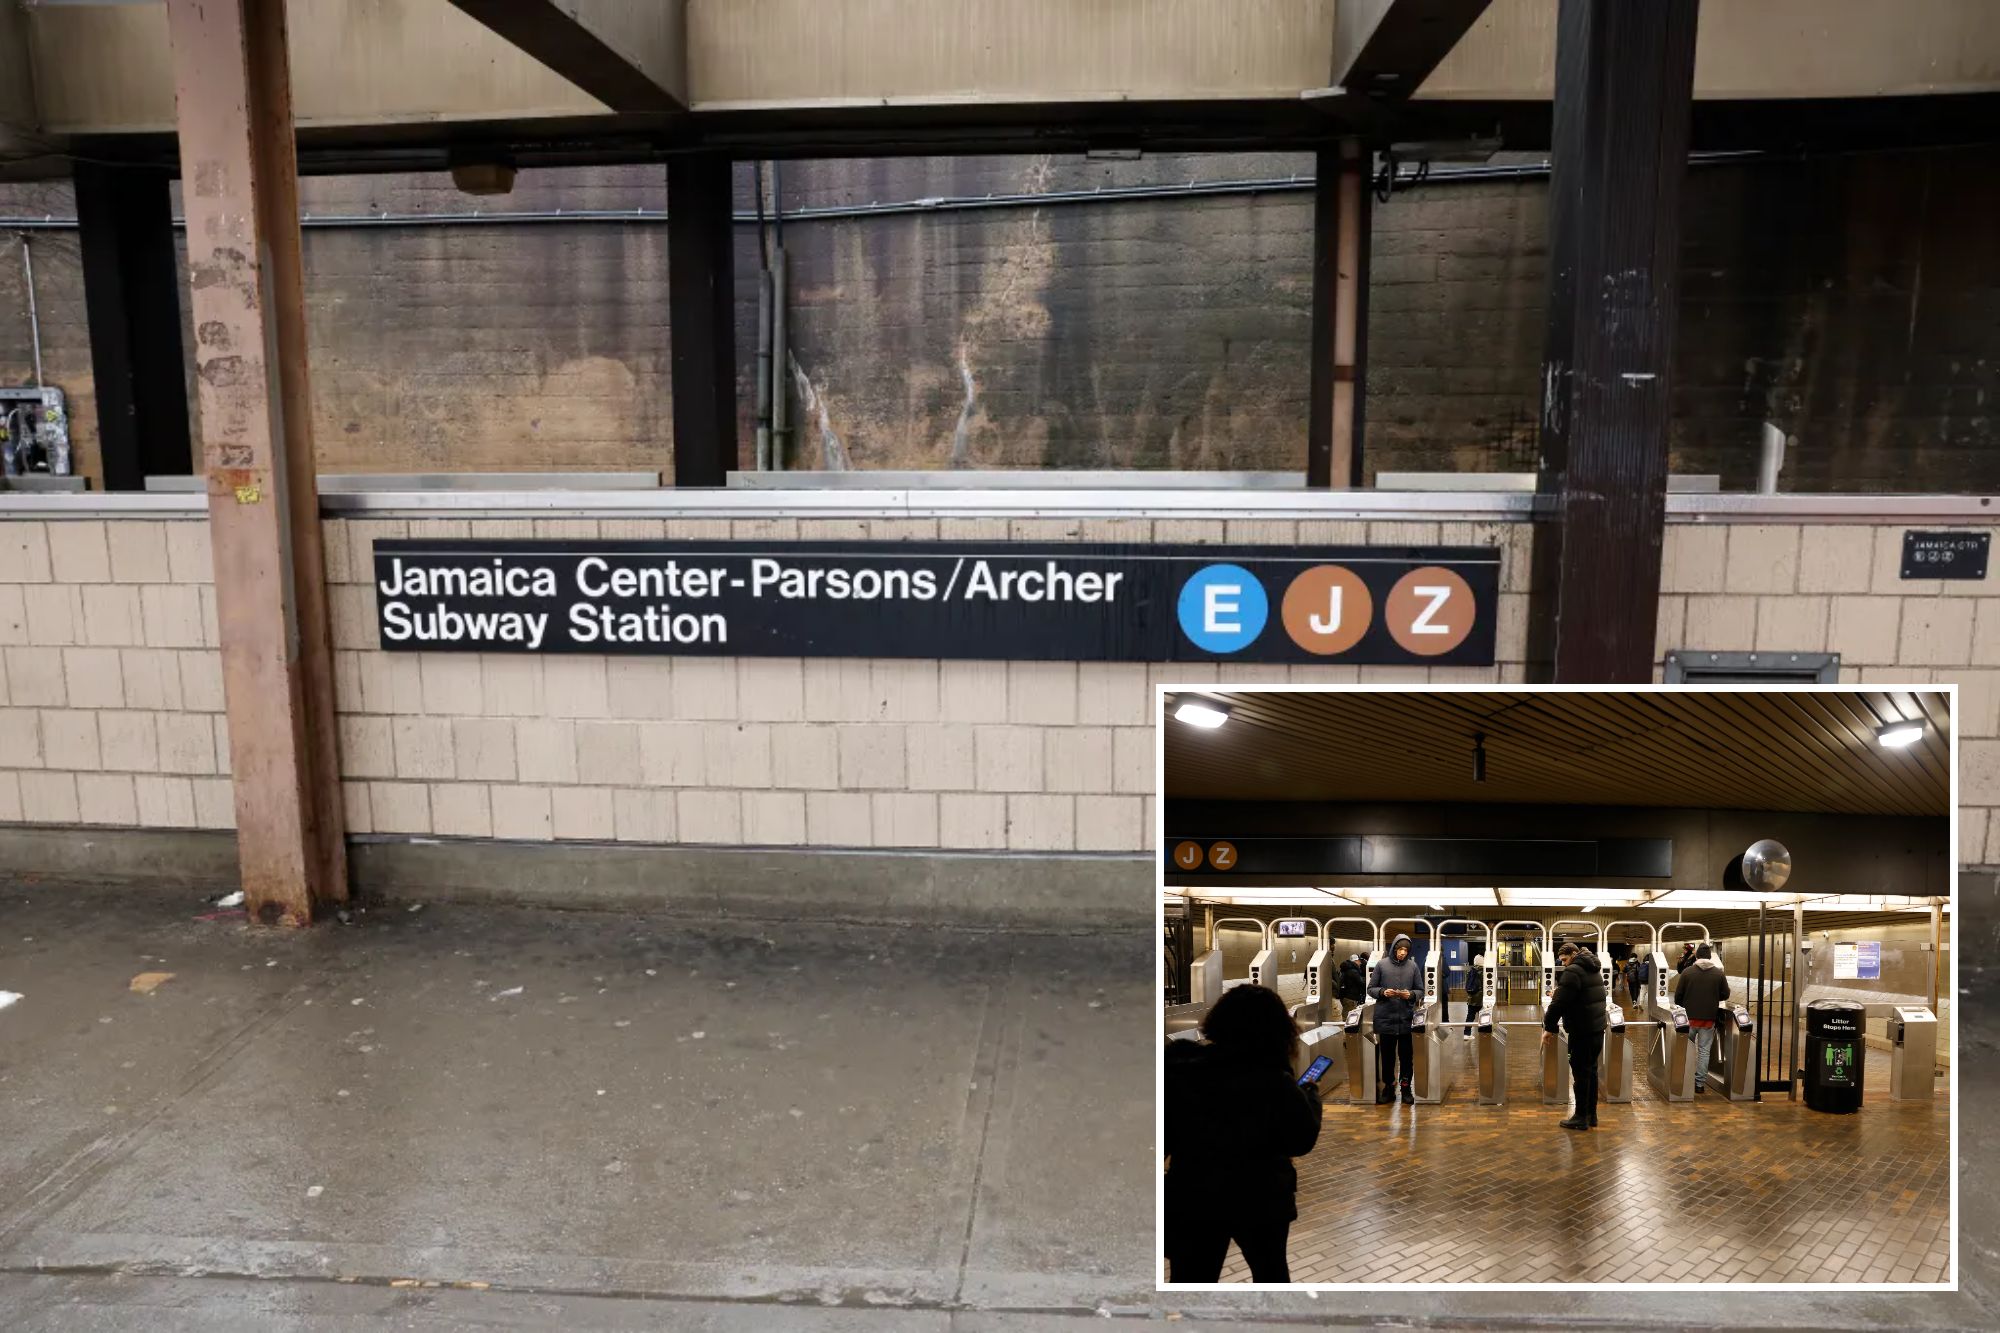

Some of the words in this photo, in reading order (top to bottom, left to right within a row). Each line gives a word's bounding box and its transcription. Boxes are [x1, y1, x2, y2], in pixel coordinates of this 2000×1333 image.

[380, 558, 558, 597] Jamaica
[383, 602, 549, 648] Subway
[568, 603, 727, 643] Station
[1204, 584, 1241, 633] E
[1309, 585, 1343, 635] J
[1410, 585, 1451, 634] Z
[1183, 847, 1194, 863] J
[1216, 848, 1230, 863] Z
